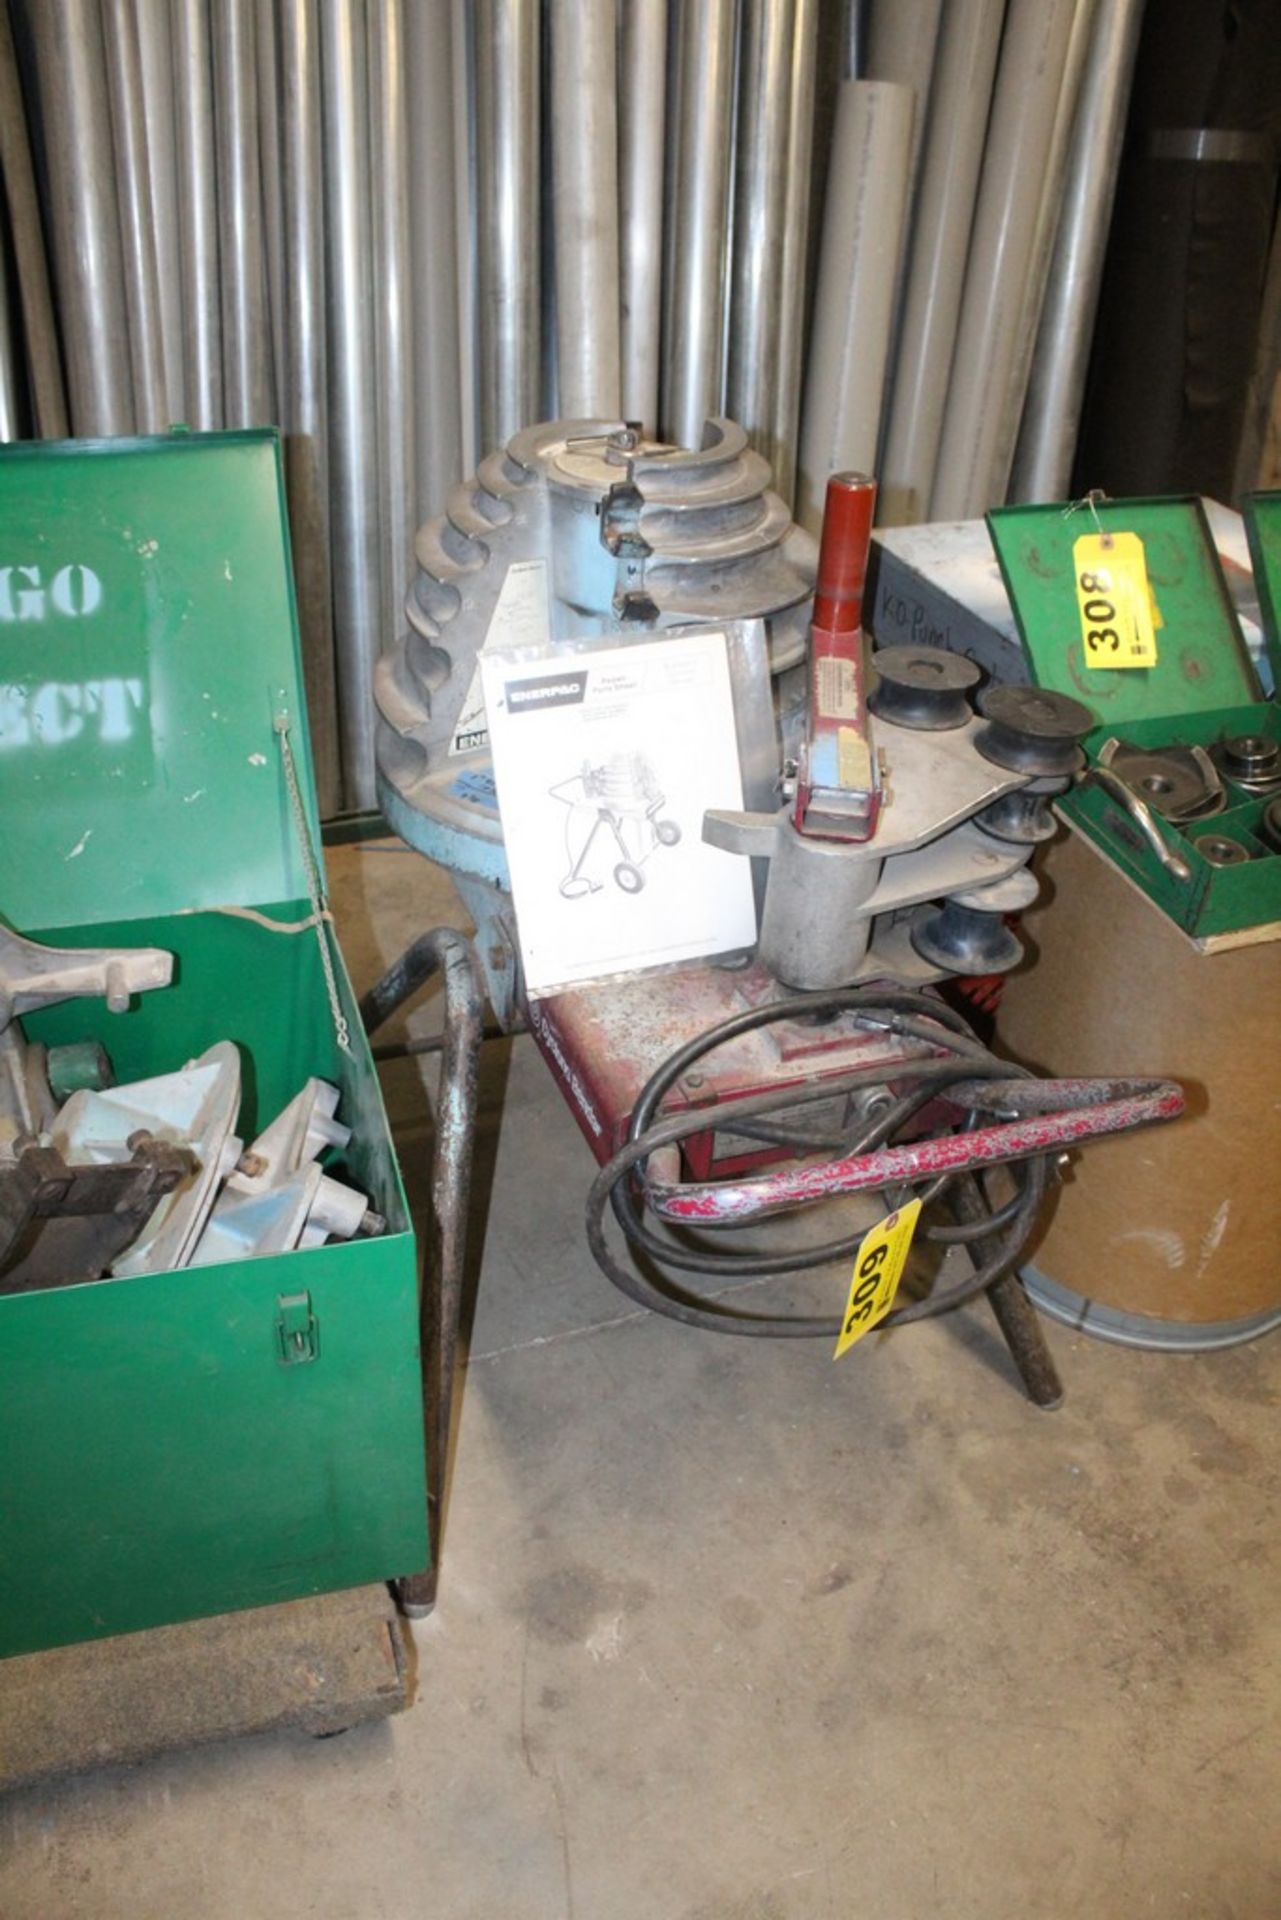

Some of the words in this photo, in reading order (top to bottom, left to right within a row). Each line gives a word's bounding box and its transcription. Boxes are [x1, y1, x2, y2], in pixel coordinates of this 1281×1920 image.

[1080, 572, 1120, 652] 308
[510, 683, 580, 702] ENERPAC
[845, 1244, 889, 1335] 309
